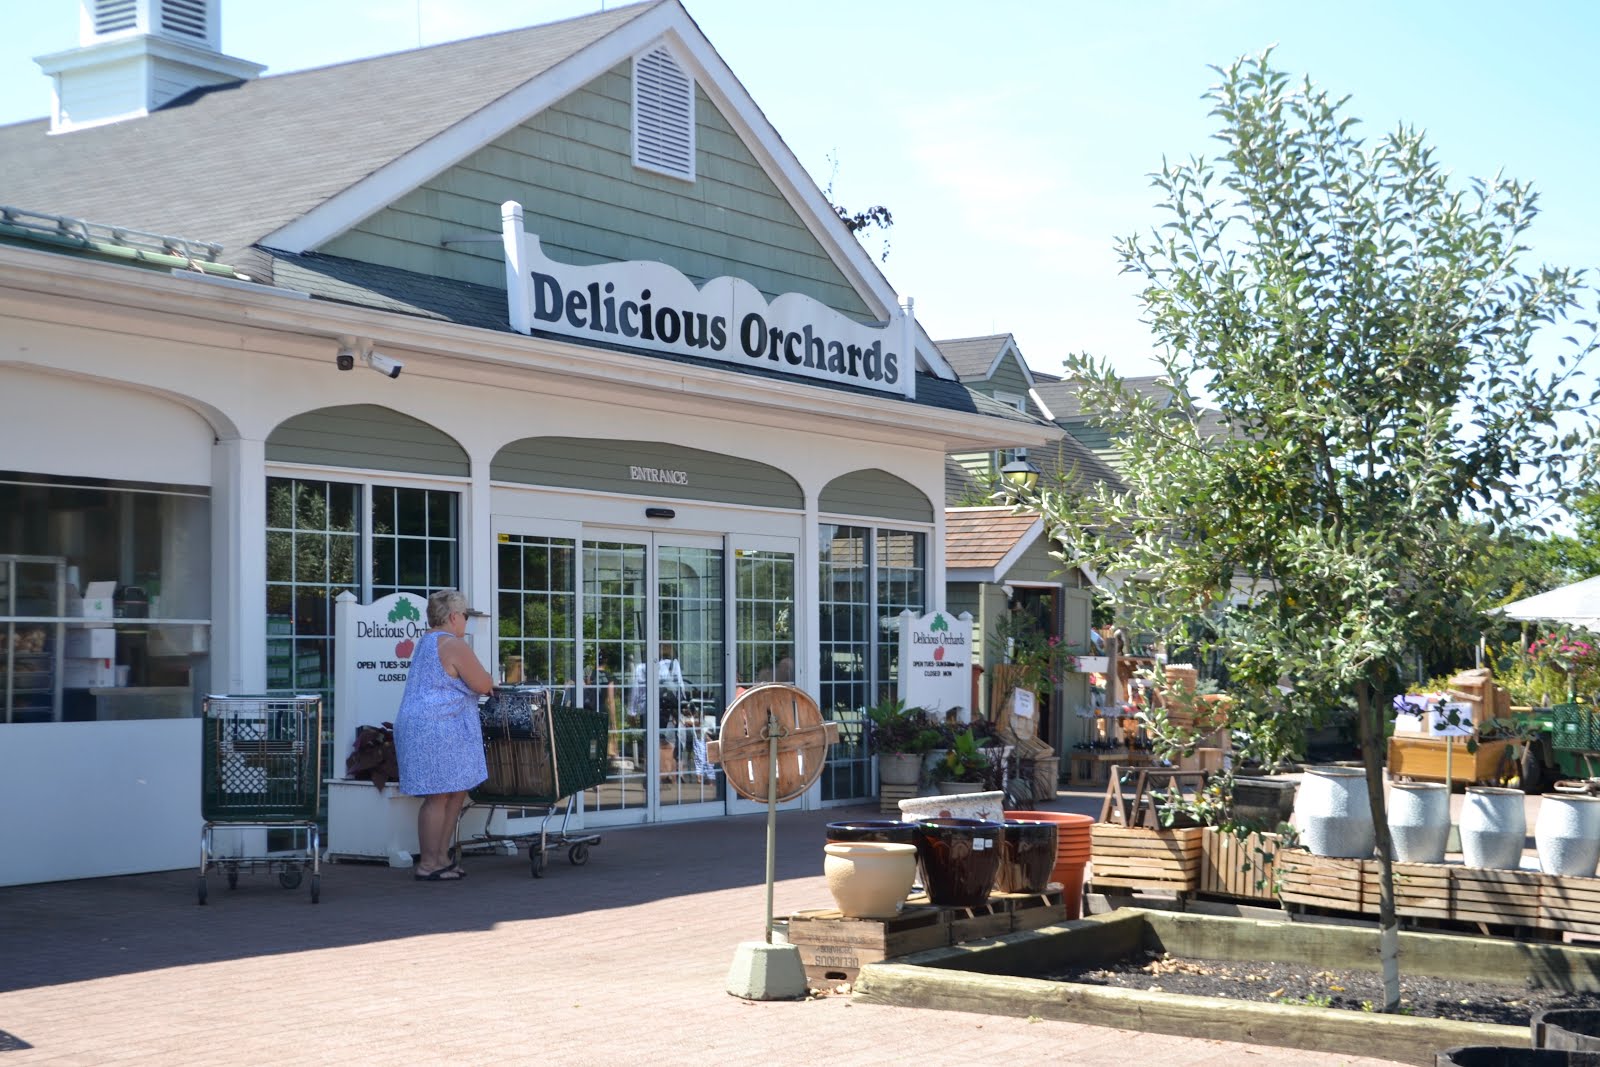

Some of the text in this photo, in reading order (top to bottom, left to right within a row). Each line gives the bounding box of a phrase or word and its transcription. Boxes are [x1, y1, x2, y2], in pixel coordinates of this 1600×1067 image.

[531, 271, 899, 385] Delicious Orchards
[630, 465, 688, 485] ENTRANCE
[357, 621, 404, 638] Delicious
[913, 631, 964, 645] Delicious Orchards
[357, 661, 376, 669] OPEN
[913, 660, 924, 668] OPEN
[378, 673, 407, 682] CLOSED
[814, 955, 859, 969] DELICIOUS
